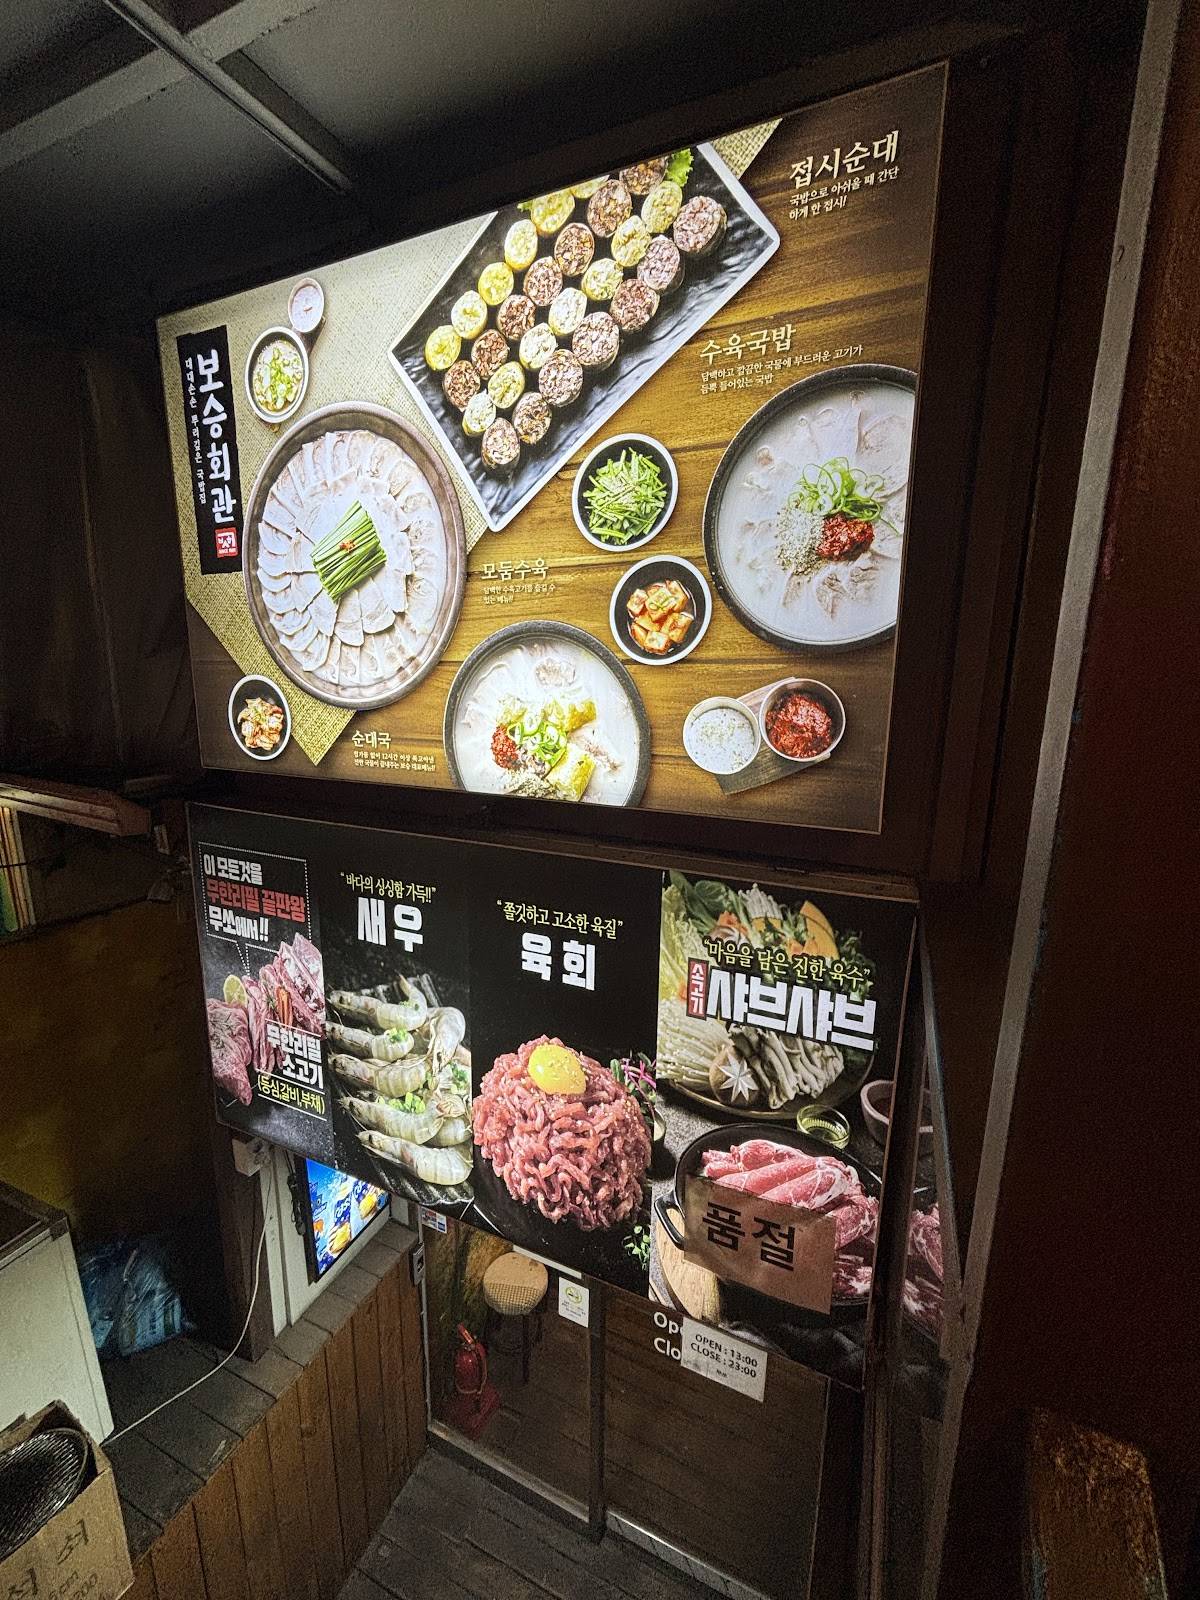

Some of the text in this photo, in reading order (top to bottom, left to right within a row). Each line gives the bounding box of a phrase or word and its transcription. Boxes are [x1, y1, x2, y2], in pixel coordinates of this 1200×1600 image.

[790, 130, 899, 189] 접시순대
[790, 166, 899, 205] 국밥으로 아쉬울 때 간단
[789, 205, 808, 220] 하게
[811, 203, 822, 216] 한
[700, 324, 797, 365] 수육국밥
[701, 345, 864, 382] 담백하고 깔끔한 국물에 부드러운 고기가
[701, 373, 775, 395] 듬뿍 들어있는 국밥
[197, 349, 237, 524] 보승회관
[481, 558, 549, 581] 모둠수육
[352, 730, 392, 749] 순대국
[400, 754, 411, 762] 이상
[203, 853, 263, 886] 이 모든것을
[206, 878, 306, 923] 무한리필 끝판왕
[375, 877, 405, 899] 싱싱함
[208, 905, 269, 942] 무쏘에서!!
[551, 911, 590, 934] 고소한
[757, 950, 790, 975] 담은
[793, 956, 827, 982] 진한
[690, 963, 705, 1015] 소고기
[706, 968, 877, 1052] 샤브샤브
[266, 1023, 322, 1063] 무한리필
[282, 1055, 324, 1089] 소고기
[702, 1202, 796, 1272] 품절
[653, 1311, 683, 1335] Op
[653, 1337, 682, 1360] Clo
[690, 1342, 721, 1363] CLOSE
[728, 1360, 757, 1378] 23:00
[695, 1334, 722, 1353] OPEN
[730, 1349, 758, 1367] 13:00
